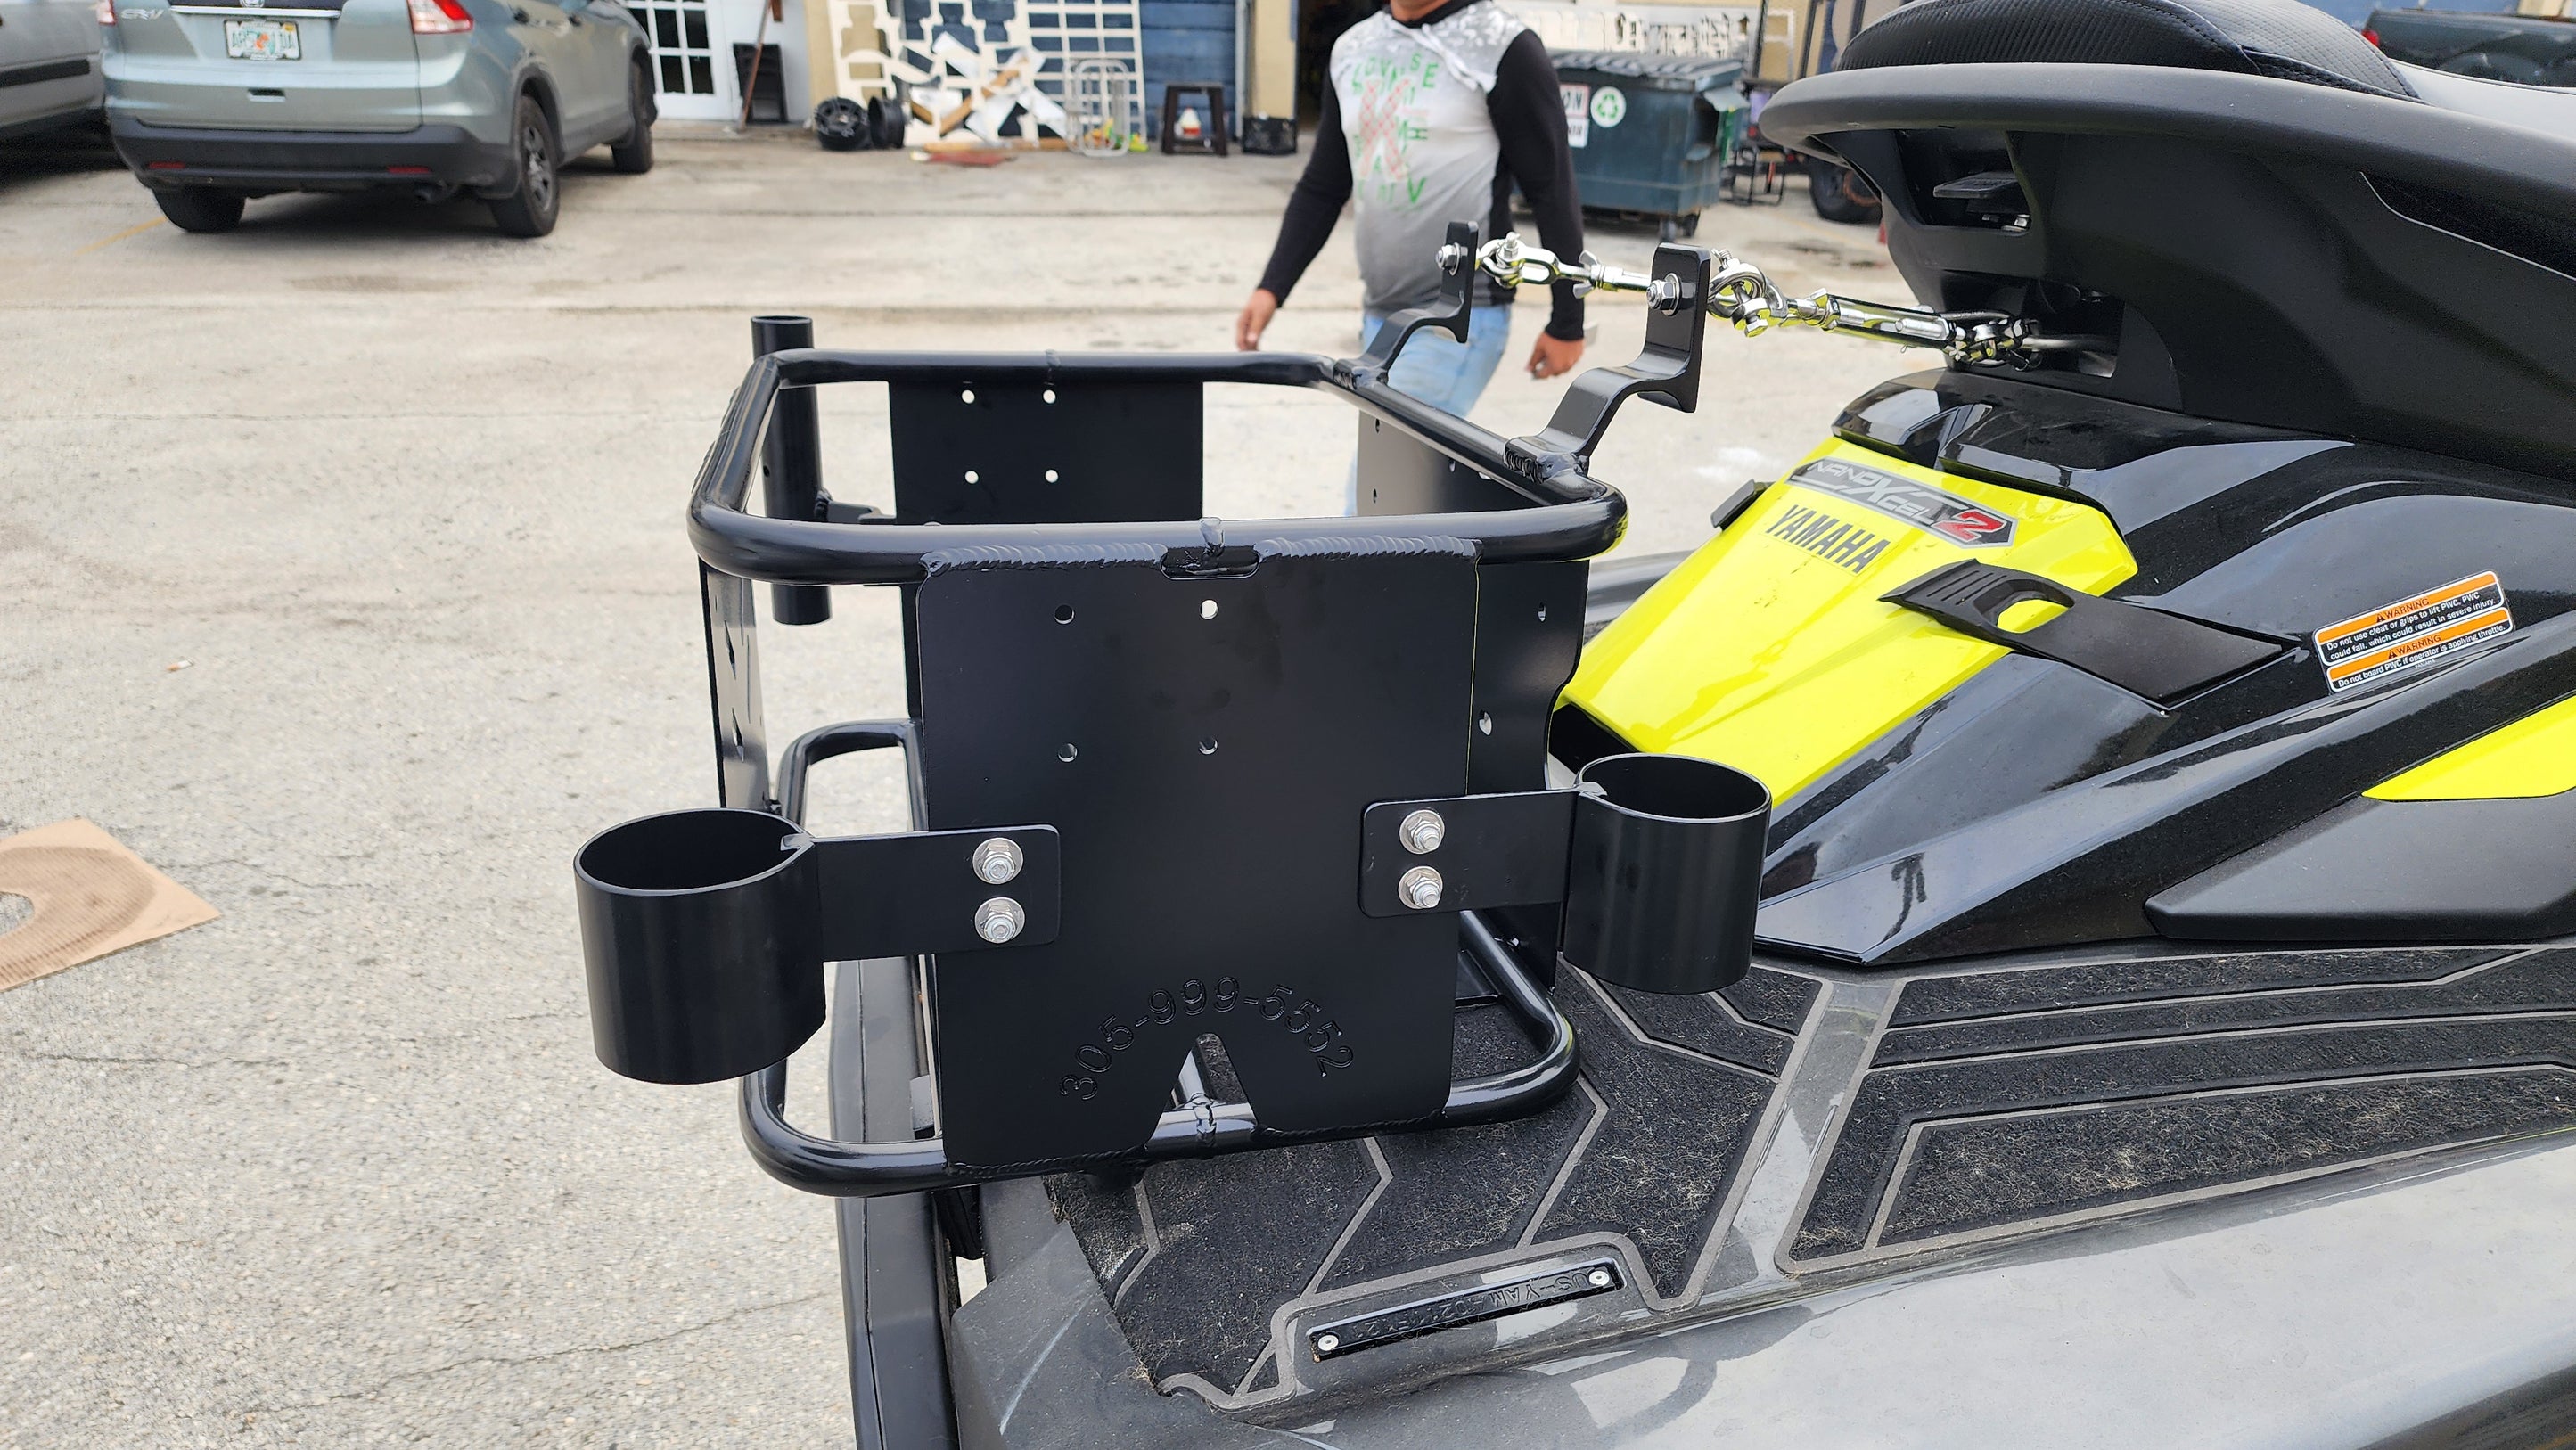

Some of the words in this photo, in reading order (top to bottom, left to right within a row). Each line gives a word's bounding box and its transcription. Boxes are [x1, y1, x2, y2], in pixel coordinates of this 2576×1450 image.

[1765, 504, 1891, 573] YAMAHA
[2326, 640, 2338, 650] Do
[2339, 635, 2352, 645] not
[2353, 630, 2367, 640] use
[2368, 623, 2389, 635] cleat
[2389, 619, 2398, 627] or
[2399, 612, 2419, 626] grips
[2419, 609, 2428, 617] to
[2429, 604, 2441, 614] lift
[2462, 591, 2480, 602] PWC
[2330, 647, 2351, 659] could
[2368, 633, 2391, 646] which
[2391, 626, 2413, 637] could
[2414, 617, 2437, 630] result
[2447, 605, 2472, 619] severe
[2473, 596, 2496, 610] injury.
[2386, 598, 2430, 619] WARNING
[2338, 677, 2350, 686] Do
[2350, 673, 2362, 682] not
[2363, 665, 2384, 677] board
[2384, 659, 2402, 669] PWC
[2408, 646, 2440, 662] operator
[2448, 633, 2478, 649] applying
[2478, 623, 2505, 637] throttle.
[2399, 635, 2441, 654] WARNING
[1060, 976, 1353, 1100] 305-999-5552
